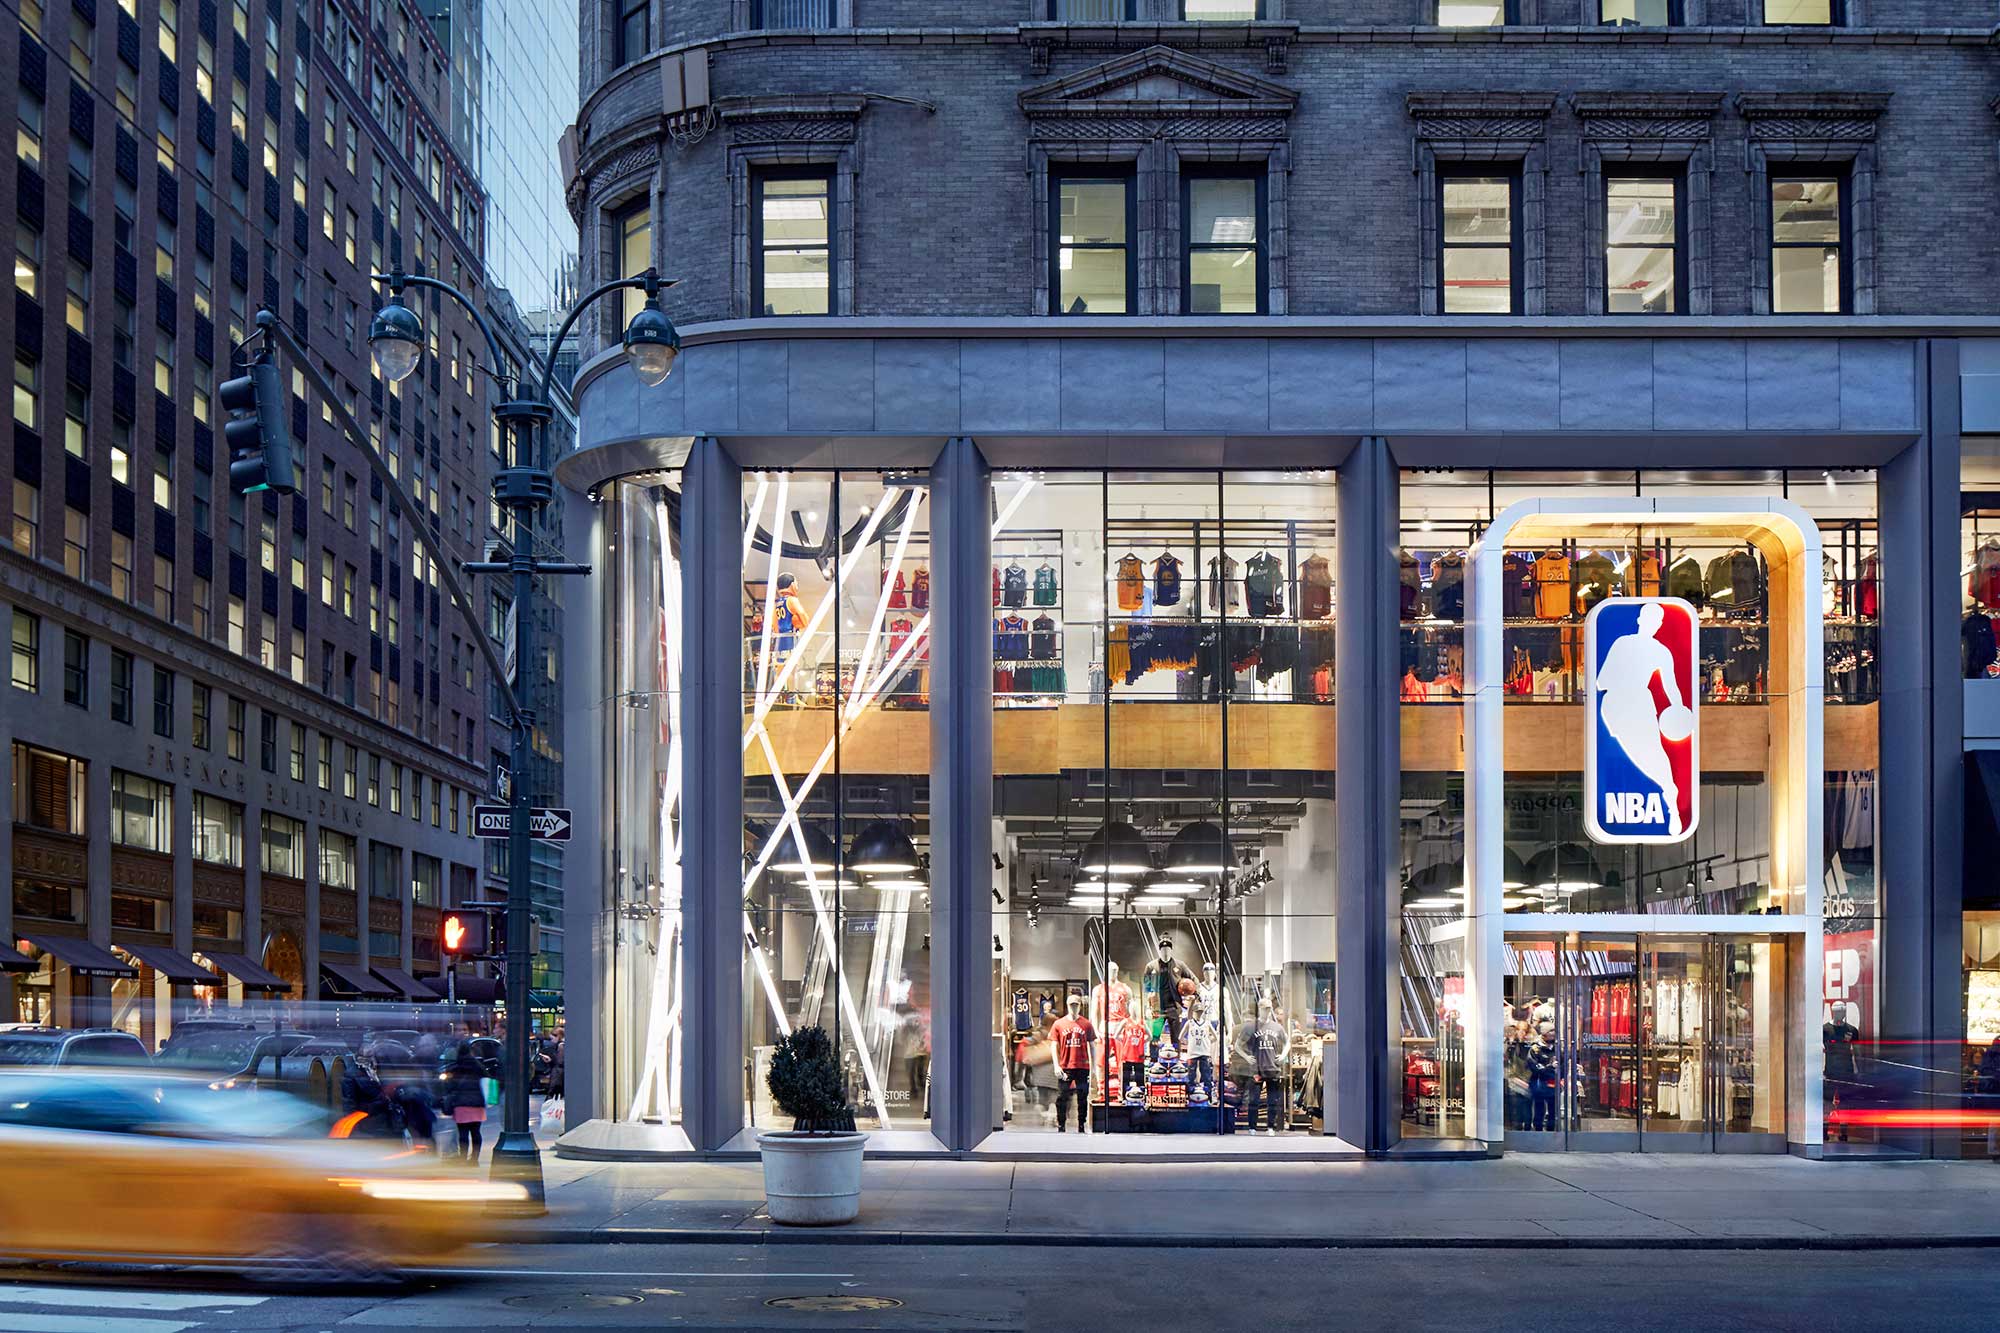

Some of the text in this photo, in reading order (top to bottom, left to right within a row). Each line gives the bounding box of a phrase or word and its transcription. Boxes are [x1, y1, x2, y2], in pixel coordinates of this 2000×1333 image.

[1546, 571, 1565, 585] 24
[776, 606, 786, 619] 30
[147, 744, 364, 829] FRENCH BUILDING
[1605, 792, 1665, 824] NBA
[482, 815, 560, 831] ONE WAY
[1823, 896, 1855, 917] didas
[1822, 948, 1861, 1000] EP
[1016, 1003, 1029, 1013] 30
